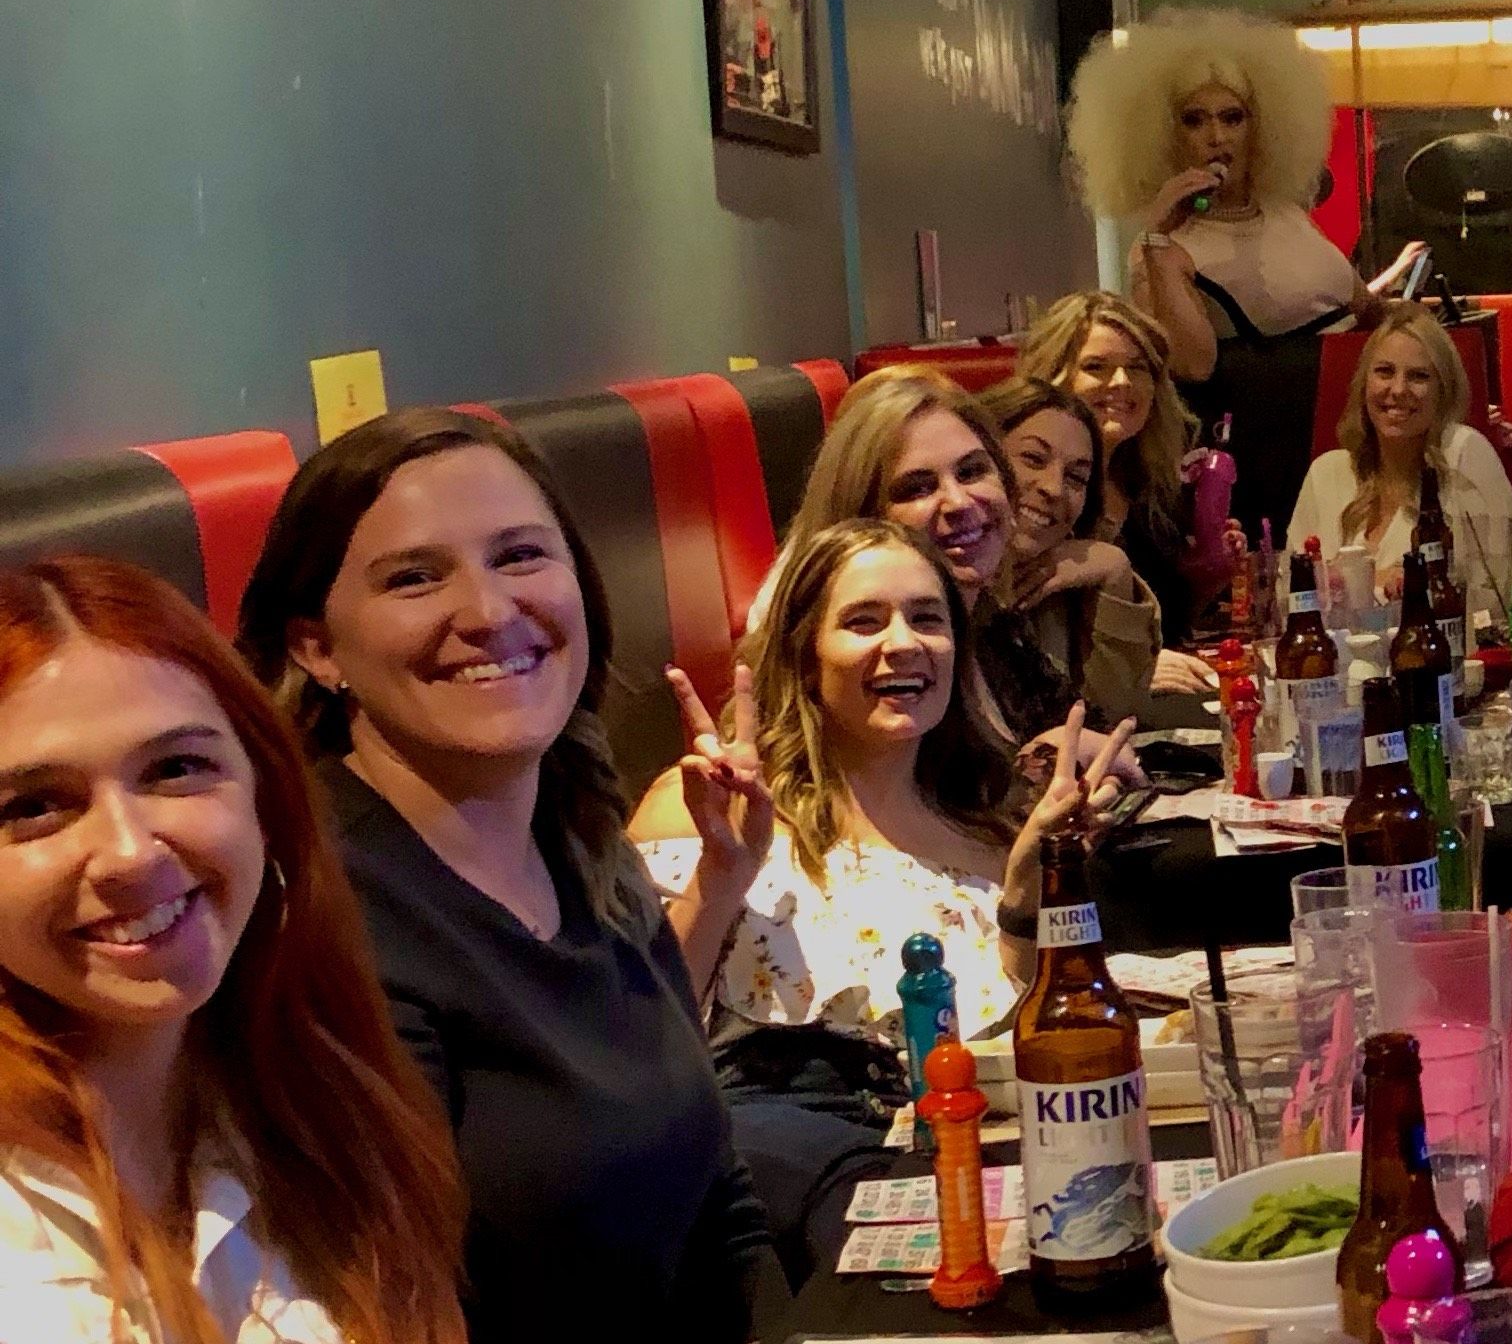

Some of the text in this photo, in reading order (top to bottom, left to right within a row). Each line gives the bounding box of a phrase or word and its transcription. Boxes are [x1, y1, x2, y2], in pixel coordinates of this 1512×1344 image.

[1048, 907, 1096, 927] KIRIN
[1049, 923, 1098, 944] LIGHT
[1035, 1077, 1140, 1124] KIRIN
